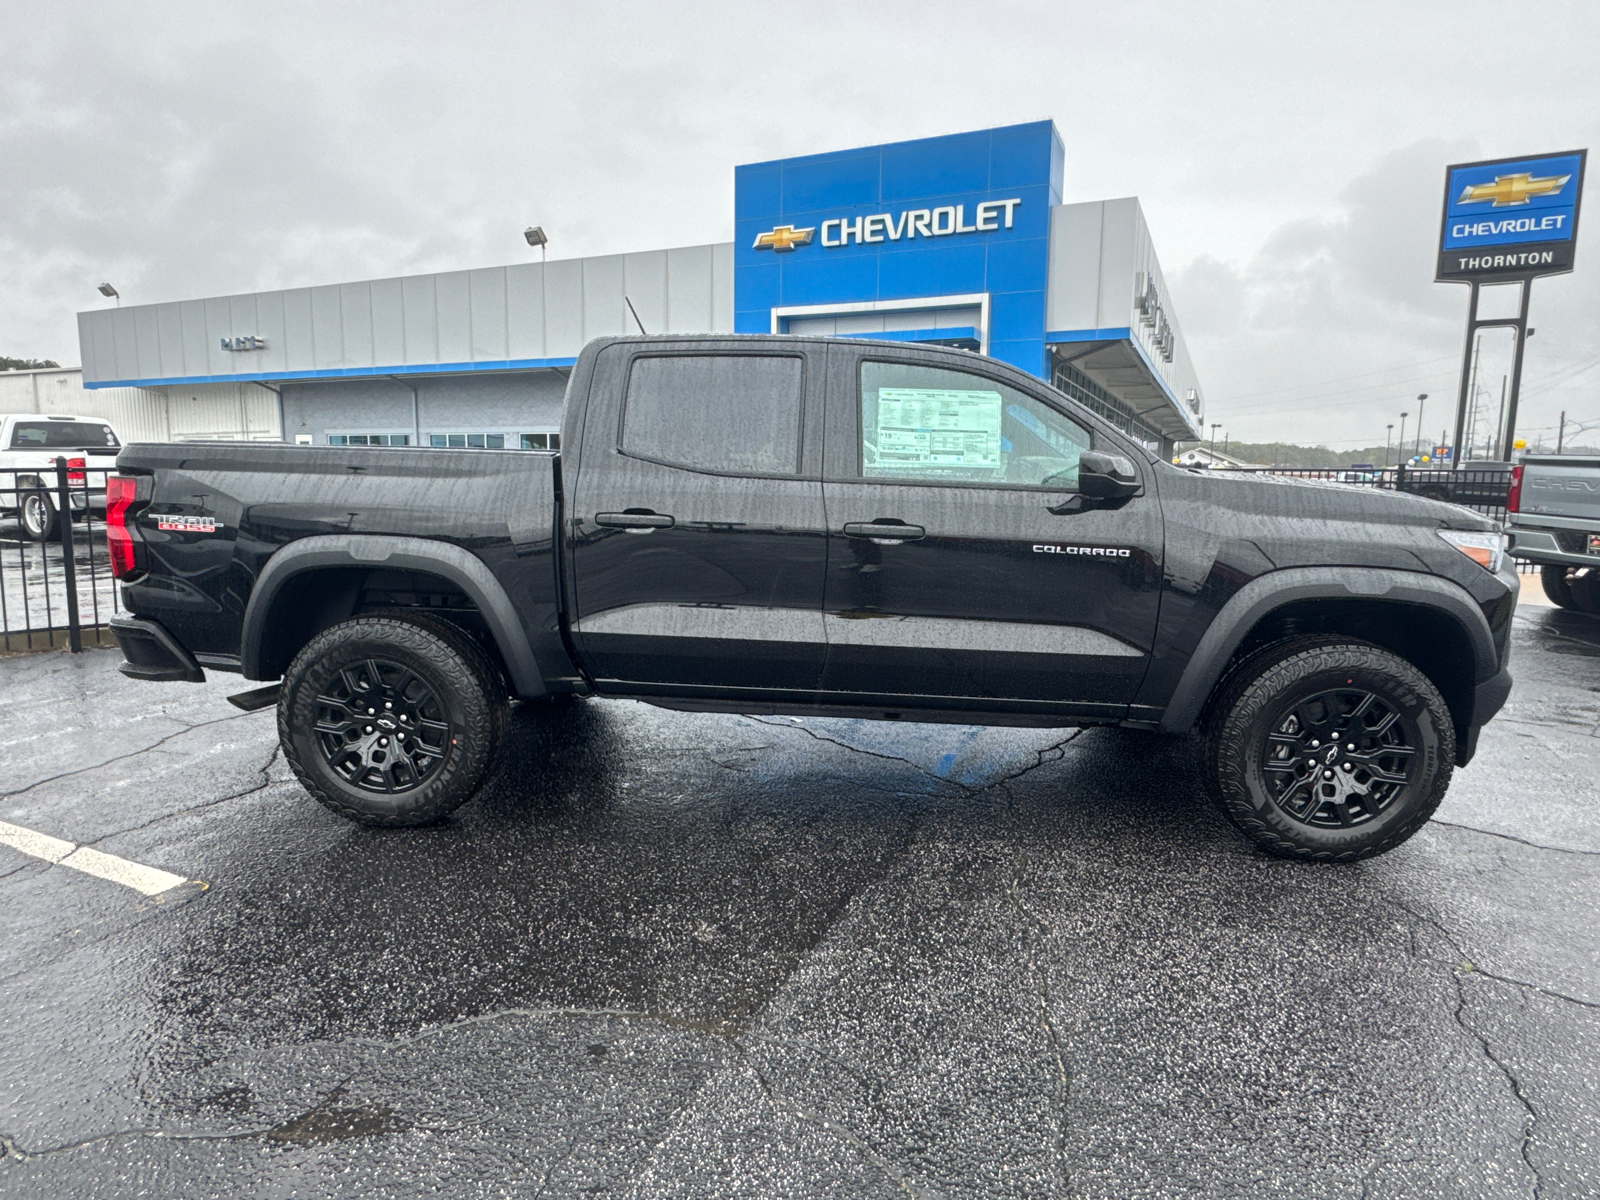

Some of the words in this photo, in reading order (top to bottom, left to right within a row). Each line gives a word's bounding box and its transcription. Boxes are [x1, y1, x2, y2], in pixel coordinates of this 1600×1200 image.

[821, 198, 1021, 247] CHEVROLET
[1452, 215, 1567, 238] CHEVROLET
[1458, 251, 1554, 270] THORNTON
[220, 335, 262, 351] PARTS
[148, 513, 224, 527] TRAIL
[158, 522, 216, 533] BOSS
[1032, 544, 1131, 558] COLORADO
